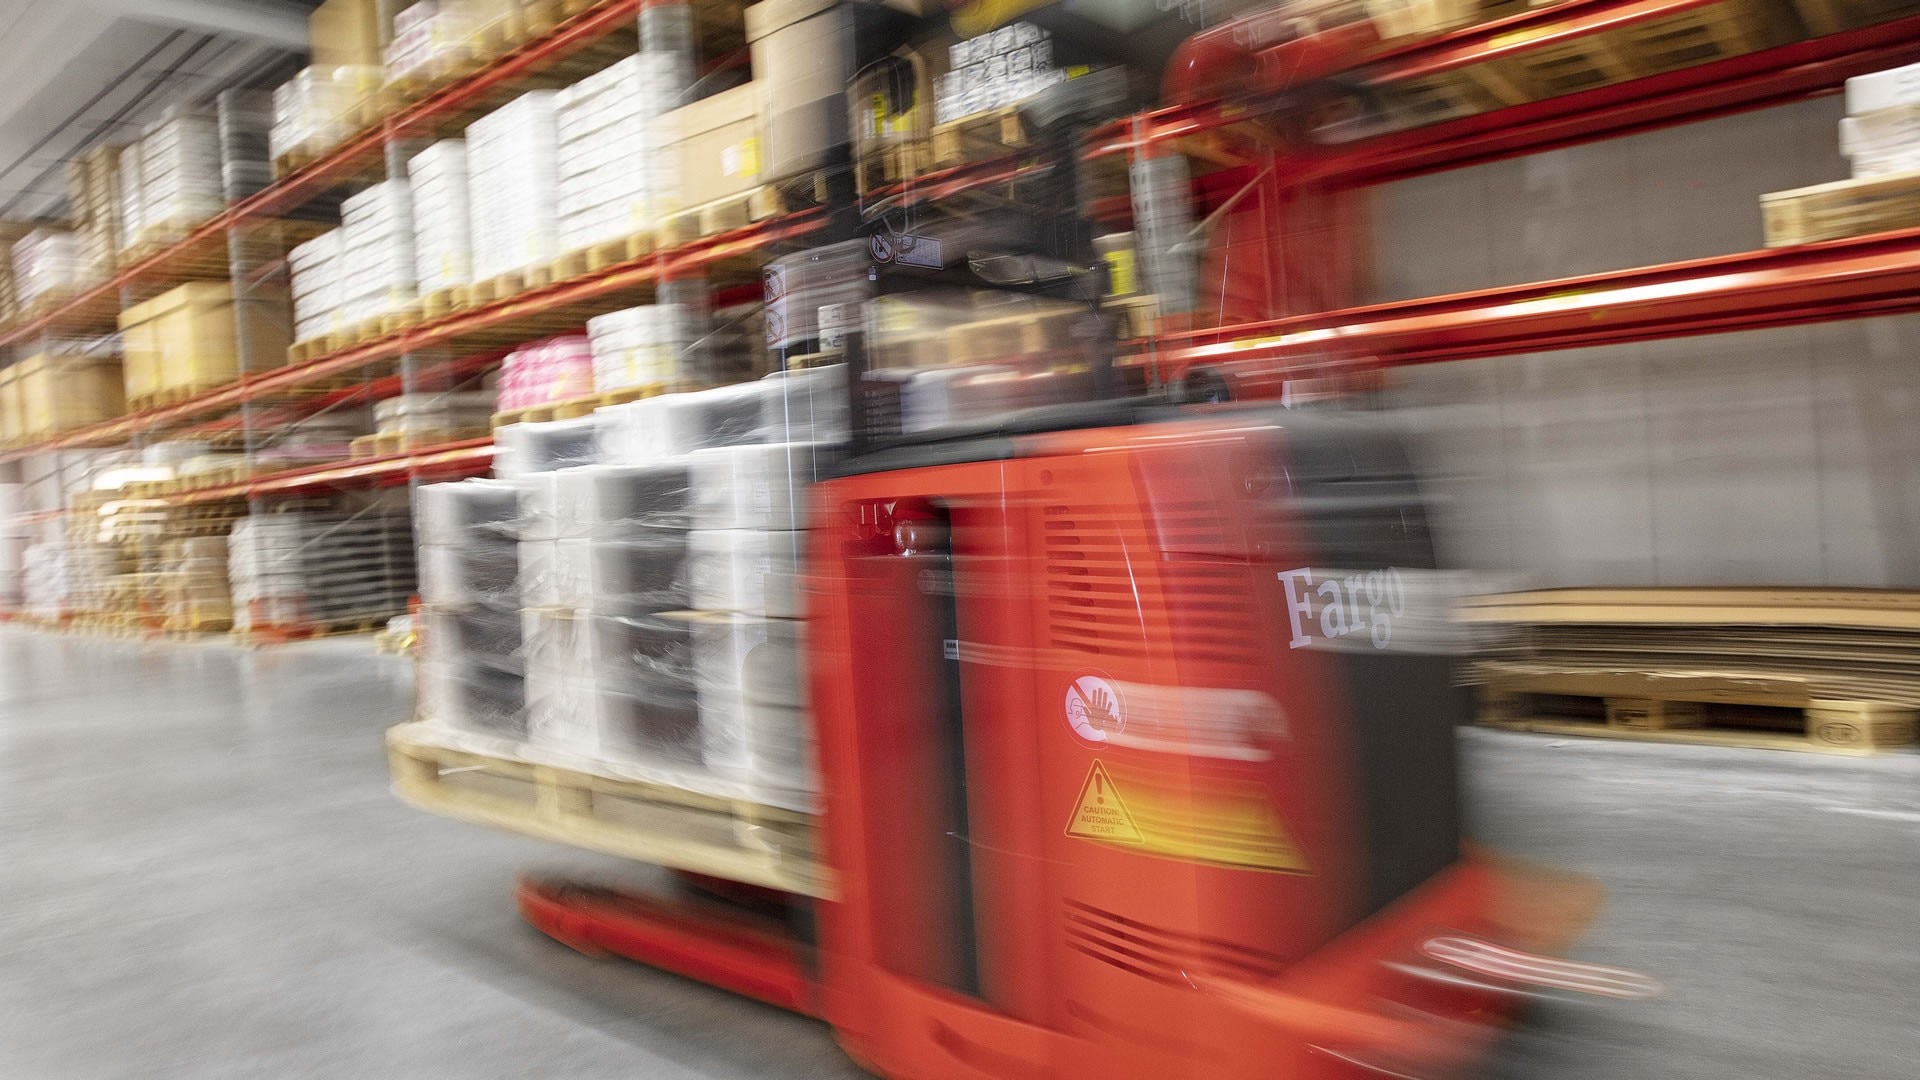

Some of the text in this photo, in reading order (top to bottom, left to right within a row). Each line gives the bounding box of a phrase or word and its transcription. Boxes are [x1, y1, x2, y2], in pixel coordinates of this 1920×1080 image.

[1277, 566, 1405, 649] Fargo
[1083, 806, 1120, 816] CAUTION!
[1081, 815, 1125, 826] AUTOMATIC
[1090, 825, 1115, 834] START
